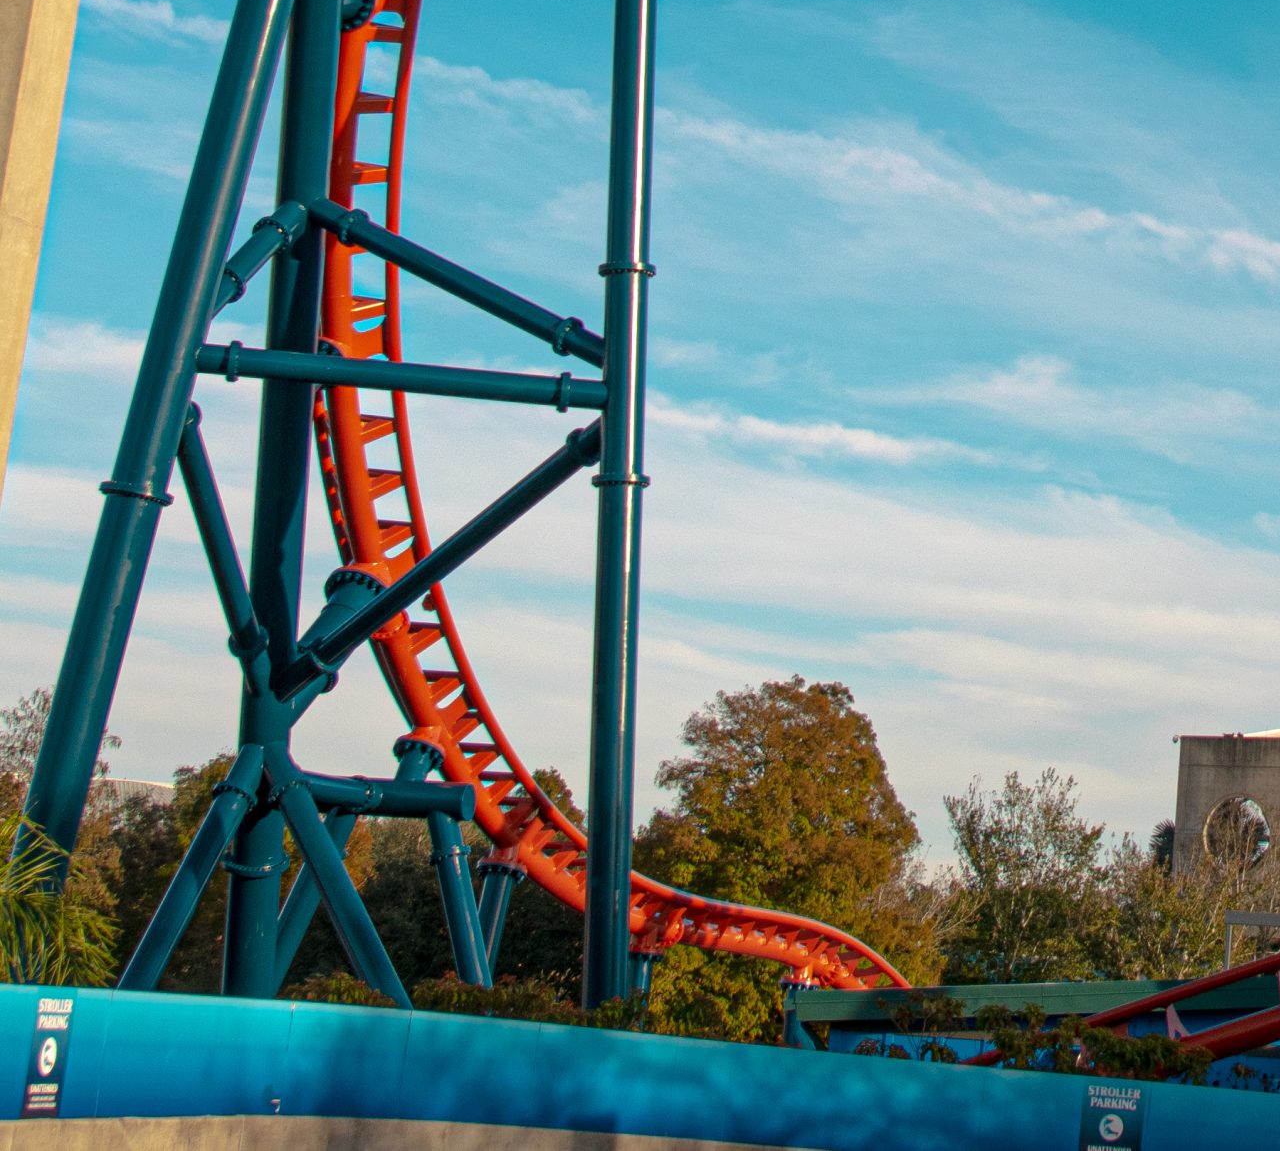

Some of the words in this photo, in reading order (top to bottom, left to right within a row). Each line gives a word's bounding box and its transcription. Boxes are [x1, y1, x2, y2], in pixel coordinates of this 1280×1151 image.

[38, 998, 74, 1013] STROLLER
[37, 1014, 69, 1030] PARKING
[1088, 1085, 1141, 1099] STROLLER
[1090, 1096, 1137, 1111] PARKING
